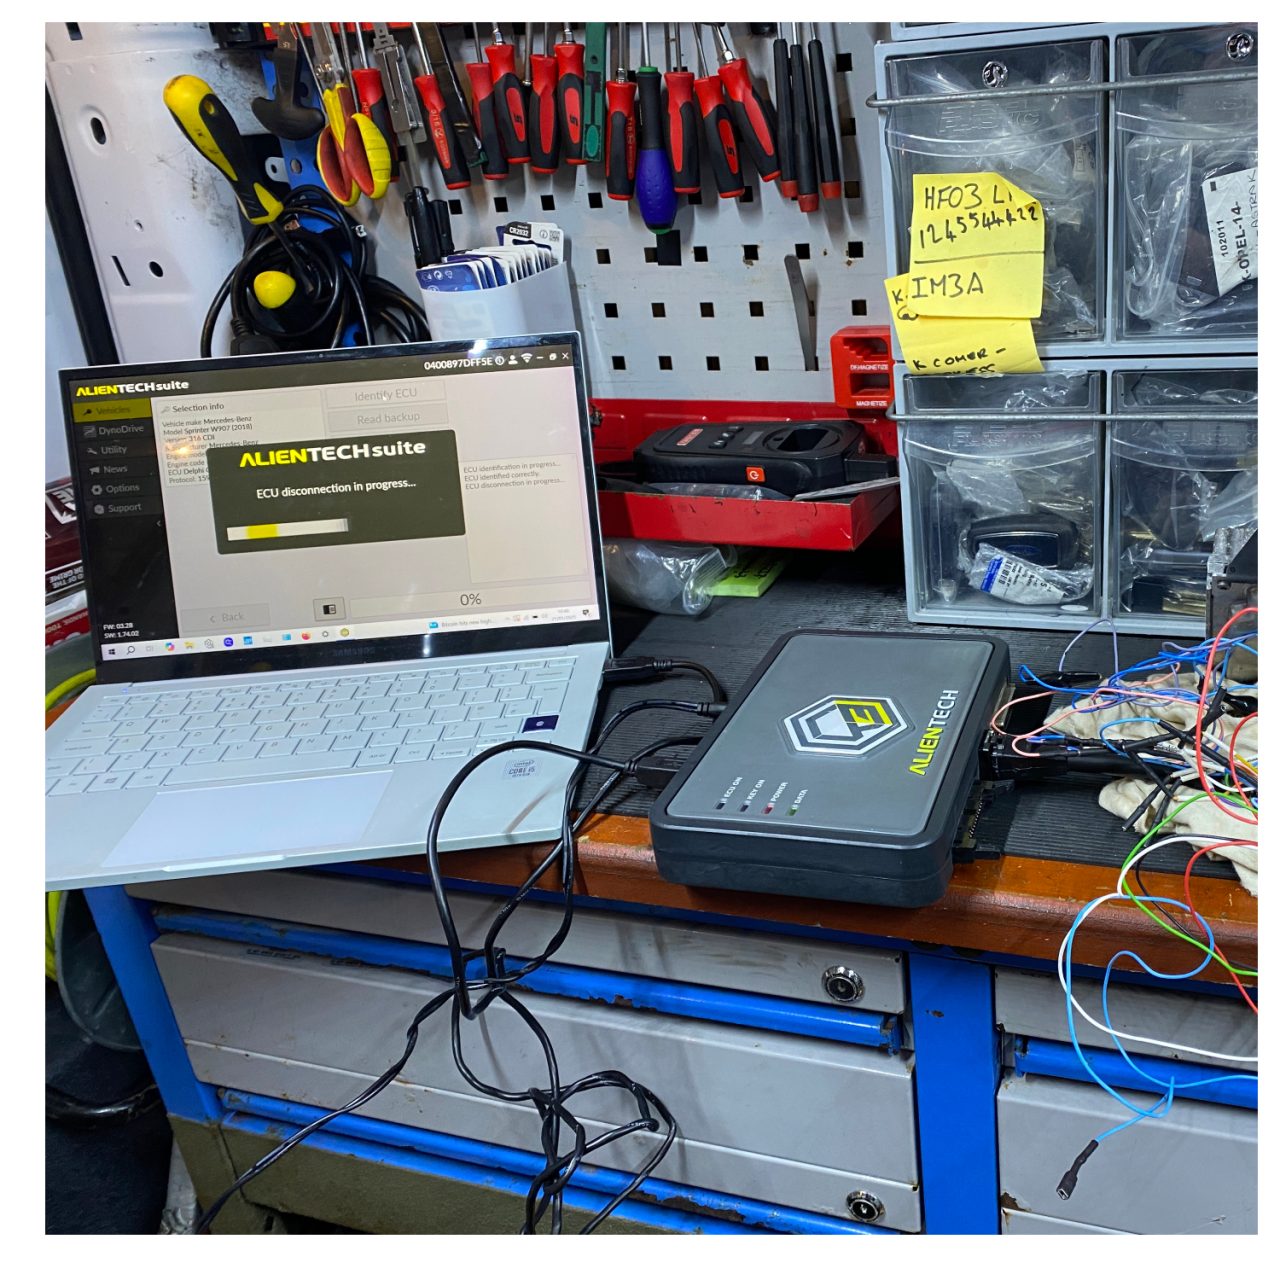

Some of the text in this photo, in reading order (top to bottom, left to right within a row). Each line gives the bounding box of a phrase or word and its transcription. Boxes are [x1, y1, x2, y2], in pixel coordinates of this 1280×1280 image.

[1216, 220, 1229, 257] 102011
[912, 271, 984, 298] IM3A
[354, 388, 417, 401] Identify ECU
[96, 405, 131, 415] Vehicles
[172, 402, 225, 413] Selection info
[203, 416, 252, 424] Mercedes-Benz
[357, 411, 420, 425] Read backup
[99, 424, 144, 436] DynoDrive
[184, 427, 209, 435] Sprinter
[101, 445, 127, 457] Utility
[103, 465, 128, 474] News
[183, 468, 205, 476] Delphi
[479, 464, 520, 472] identification
[105, 483, 140, 494] Options
[256, 480, 417, 499] ECU disconnection in progress...
[481, 480, 525, 488] disconnection
[108, 503, 142, 514] Support
[459, 593, 482, 606] 0%
[222, 611, 244, 622] Back
[909, 690, 959, 776] ALIENTECH
[723, 776, 743, 798] ECU ON
[746, 779, 765, 800] KEY ON
[770, 782, 788, 802] POWER
[794, 789, 809, 804] DATA
